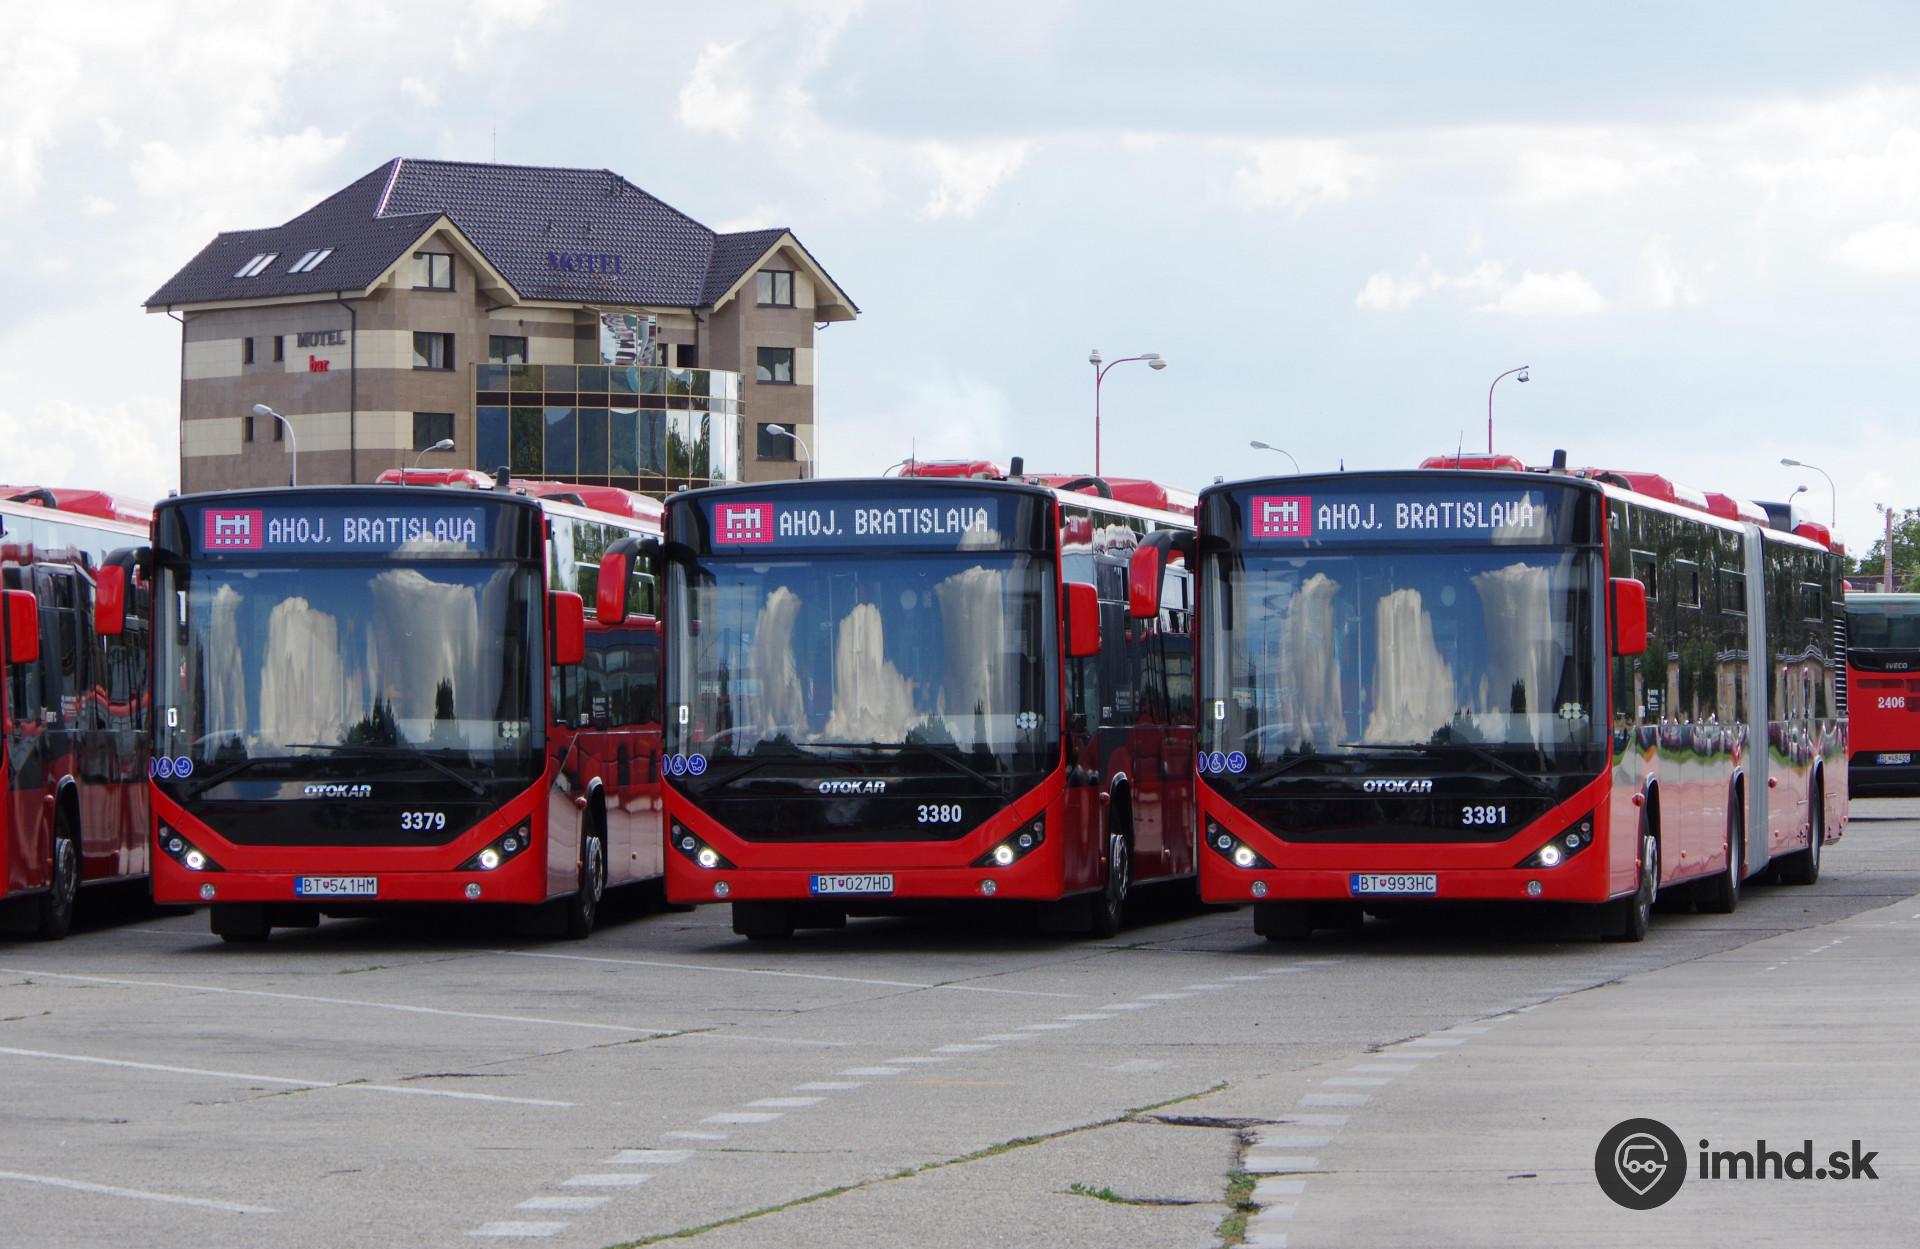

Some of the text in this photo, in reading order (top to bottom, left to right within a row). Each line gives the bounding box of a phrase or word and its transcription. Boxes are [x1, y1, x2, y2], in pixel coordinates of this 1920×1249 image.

[296, 329, 346, 347] MOTEL
[309, 354, 330, 373] bar
[779, 506, 988, 536] AHOJ, BRATISLAVA
[1318, 501, 1533, 530] AHOJ, BRATISLAVA
[268, 517, 477, 544] AHOJ, BRATISLAVA
[1877, 696, 1905, 709] 2406
[304, 784, 372, 798] OTOKAR
[818, 781, 886, 794] OTOKAR
[1363, 780, 1433, 793] OTOKAR
[401, 811, 446, 830] 3379
[917, 804, 962, 823] 3380
[1462, 805, 1507, 825] 3381
